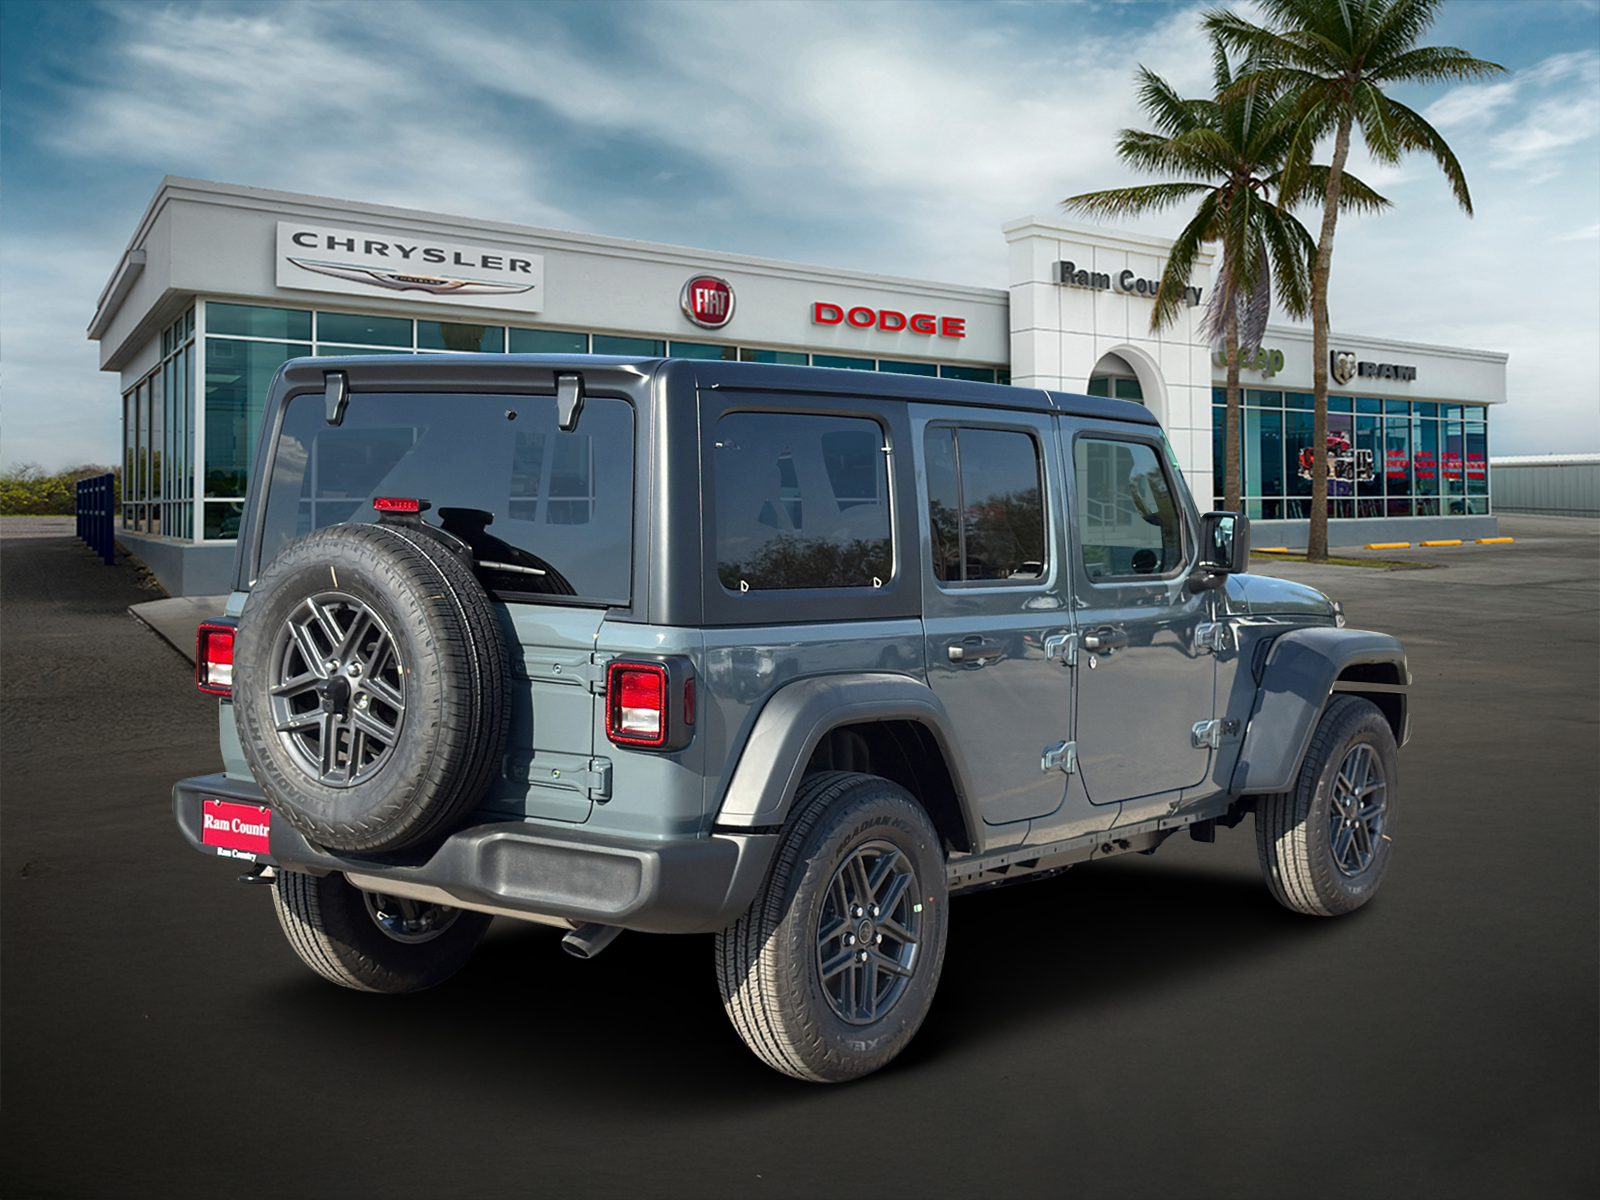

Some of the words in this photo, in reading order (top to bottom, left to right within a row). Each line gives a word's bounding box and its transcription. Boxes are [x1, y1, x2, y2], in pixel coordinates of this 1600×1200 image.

[292, 232, 532, 274] CHRYSLER
[1053, 260, 1110, 291] Ram
[695, 288, 727, 316] FIAT
[812, 302, 966, 338] DODGE
[1358, 362, 1416, 381] RAM
[204, 814, 230, 831] Ram
